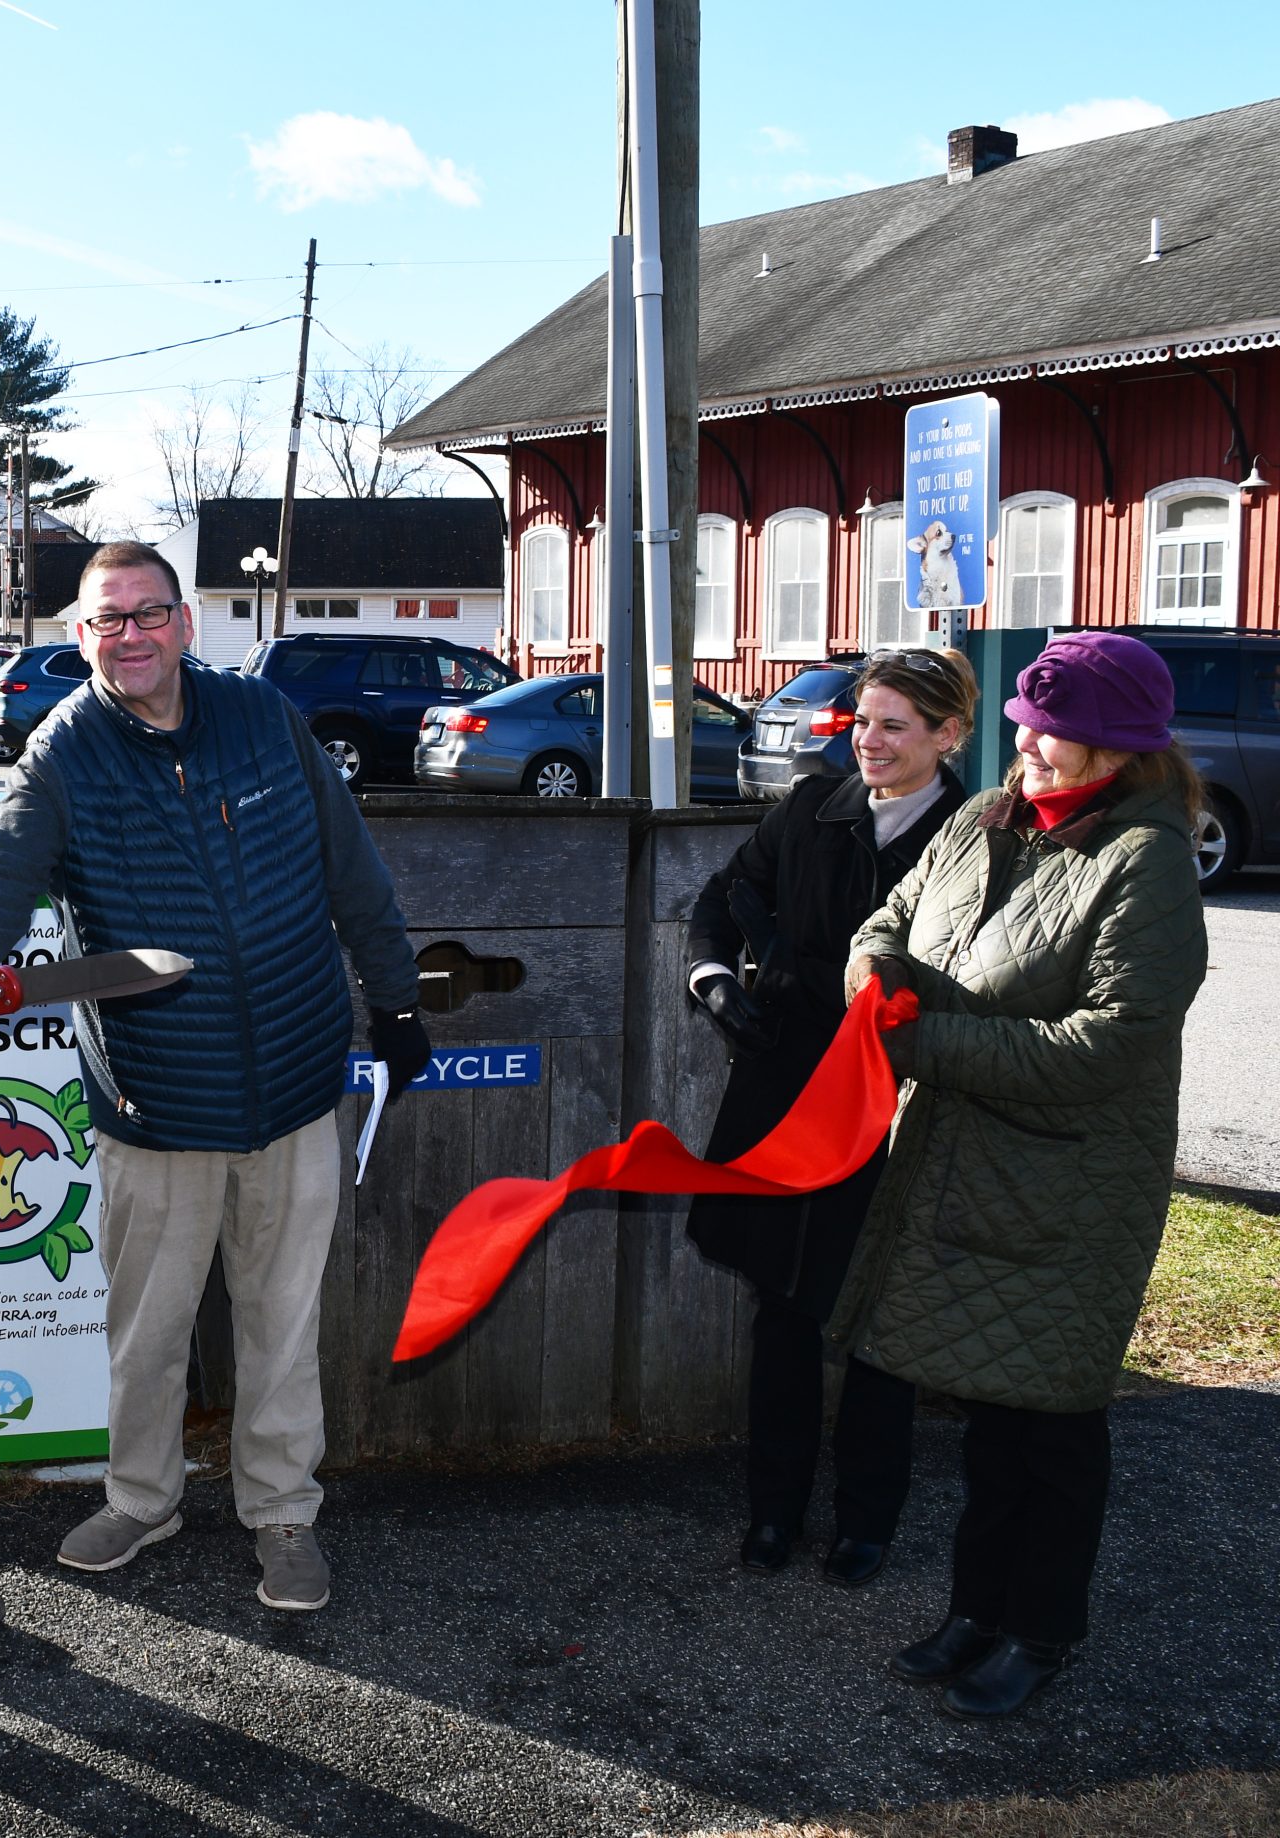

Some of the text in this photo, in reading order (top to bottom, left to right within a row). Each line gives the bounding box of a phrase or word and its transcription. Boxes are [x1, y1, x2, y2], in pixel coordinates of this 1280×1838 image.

[918, 423, 972, 445] IF YOUR DOG POOPS
[910, 450, 921, 464] AND
[923, 448, 931, 462] NO
[933, 446, 945, 460] ONE
[946, 444, 952, 458] IS
[916, 469, 973, 494] YOU STILL NEED
[919, 494, 969, 516] TO PICK IT UP.
[26, 922, 64, 939] mak
[353, 1054, 527, 1085] RYCLE
[22, 1293, 52, 1303] scan
[57, 1286, 88, 1300] code
[93, 1288, 109, 1298] or
[42, 1322, 107, 1338] Info@HRR
